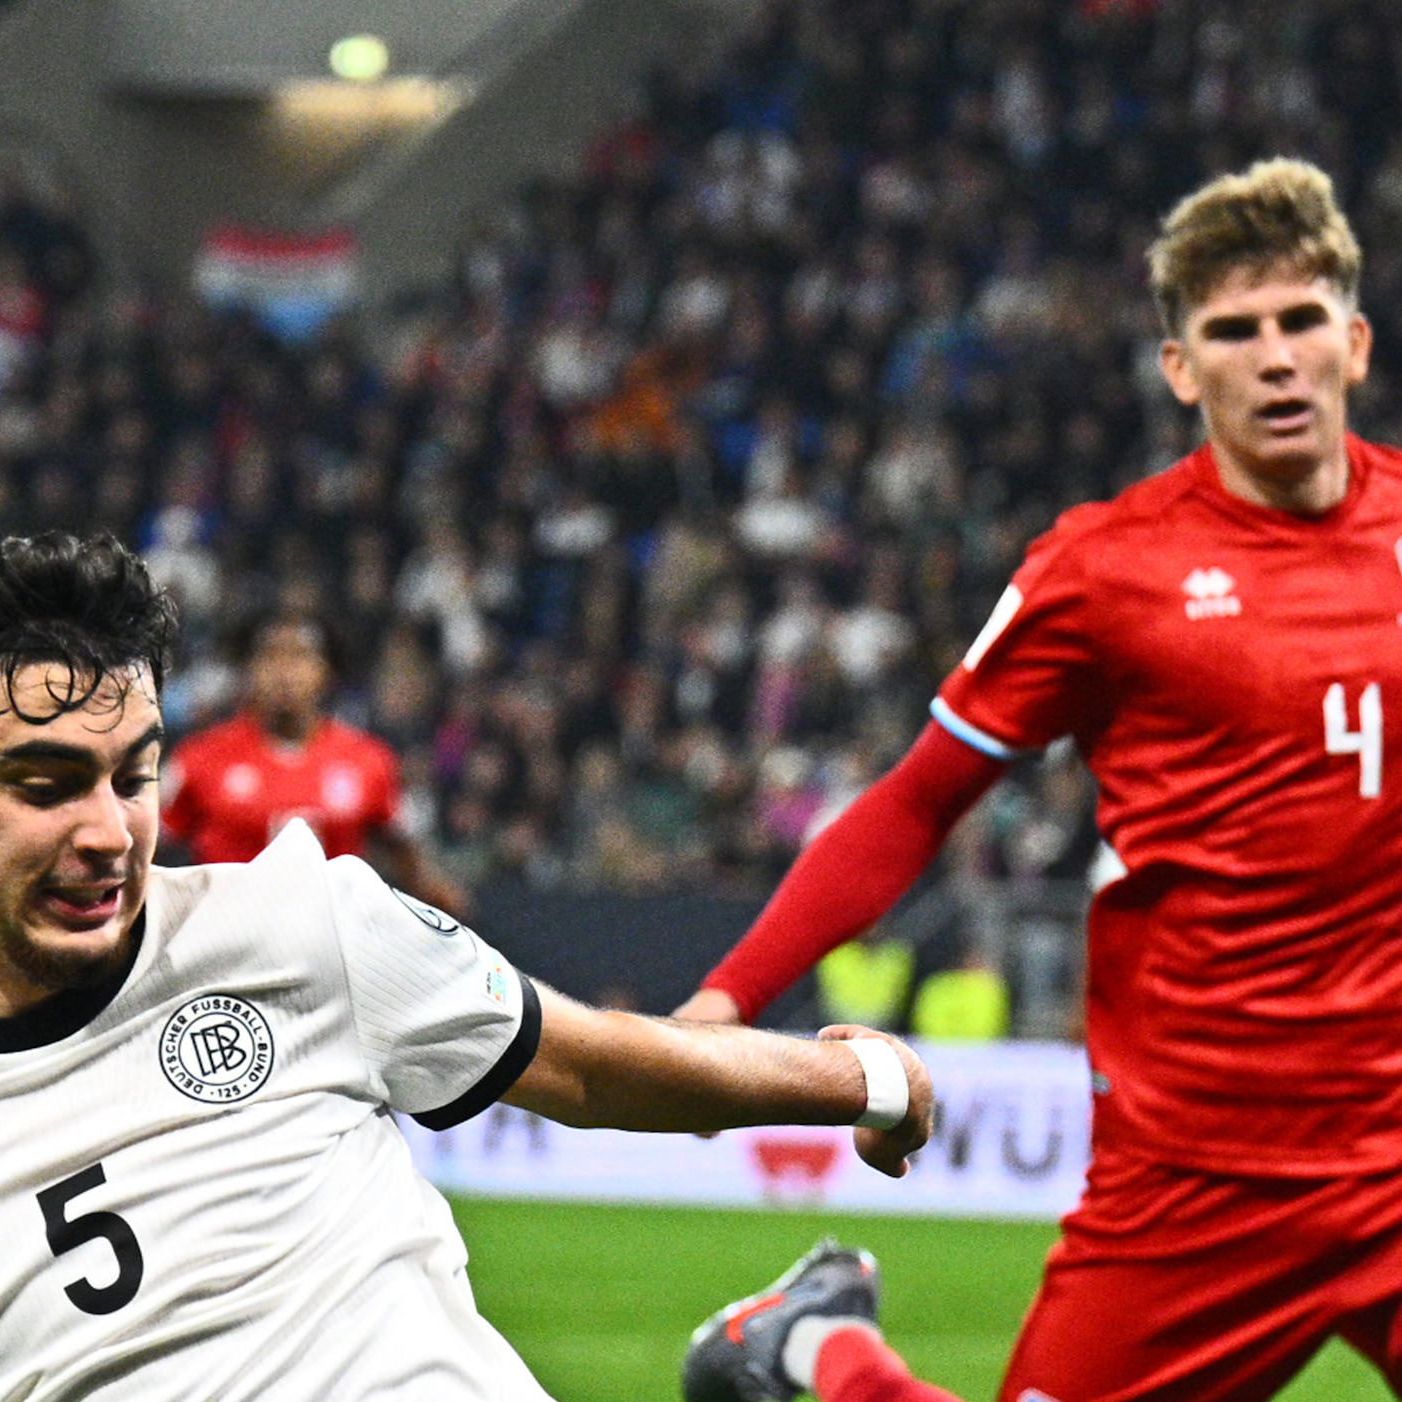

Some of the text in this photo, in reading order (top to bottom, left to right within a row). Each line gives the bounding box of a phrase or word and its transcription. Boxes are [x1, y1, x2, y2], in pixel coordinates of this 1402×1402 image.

[1322, 681, 1383, 799] 4
[165, 1015, 204, 1094] DEUTSCHER
[217, 1085, 241, 1098] 125
[35, 1162, 145, 1316] 5
